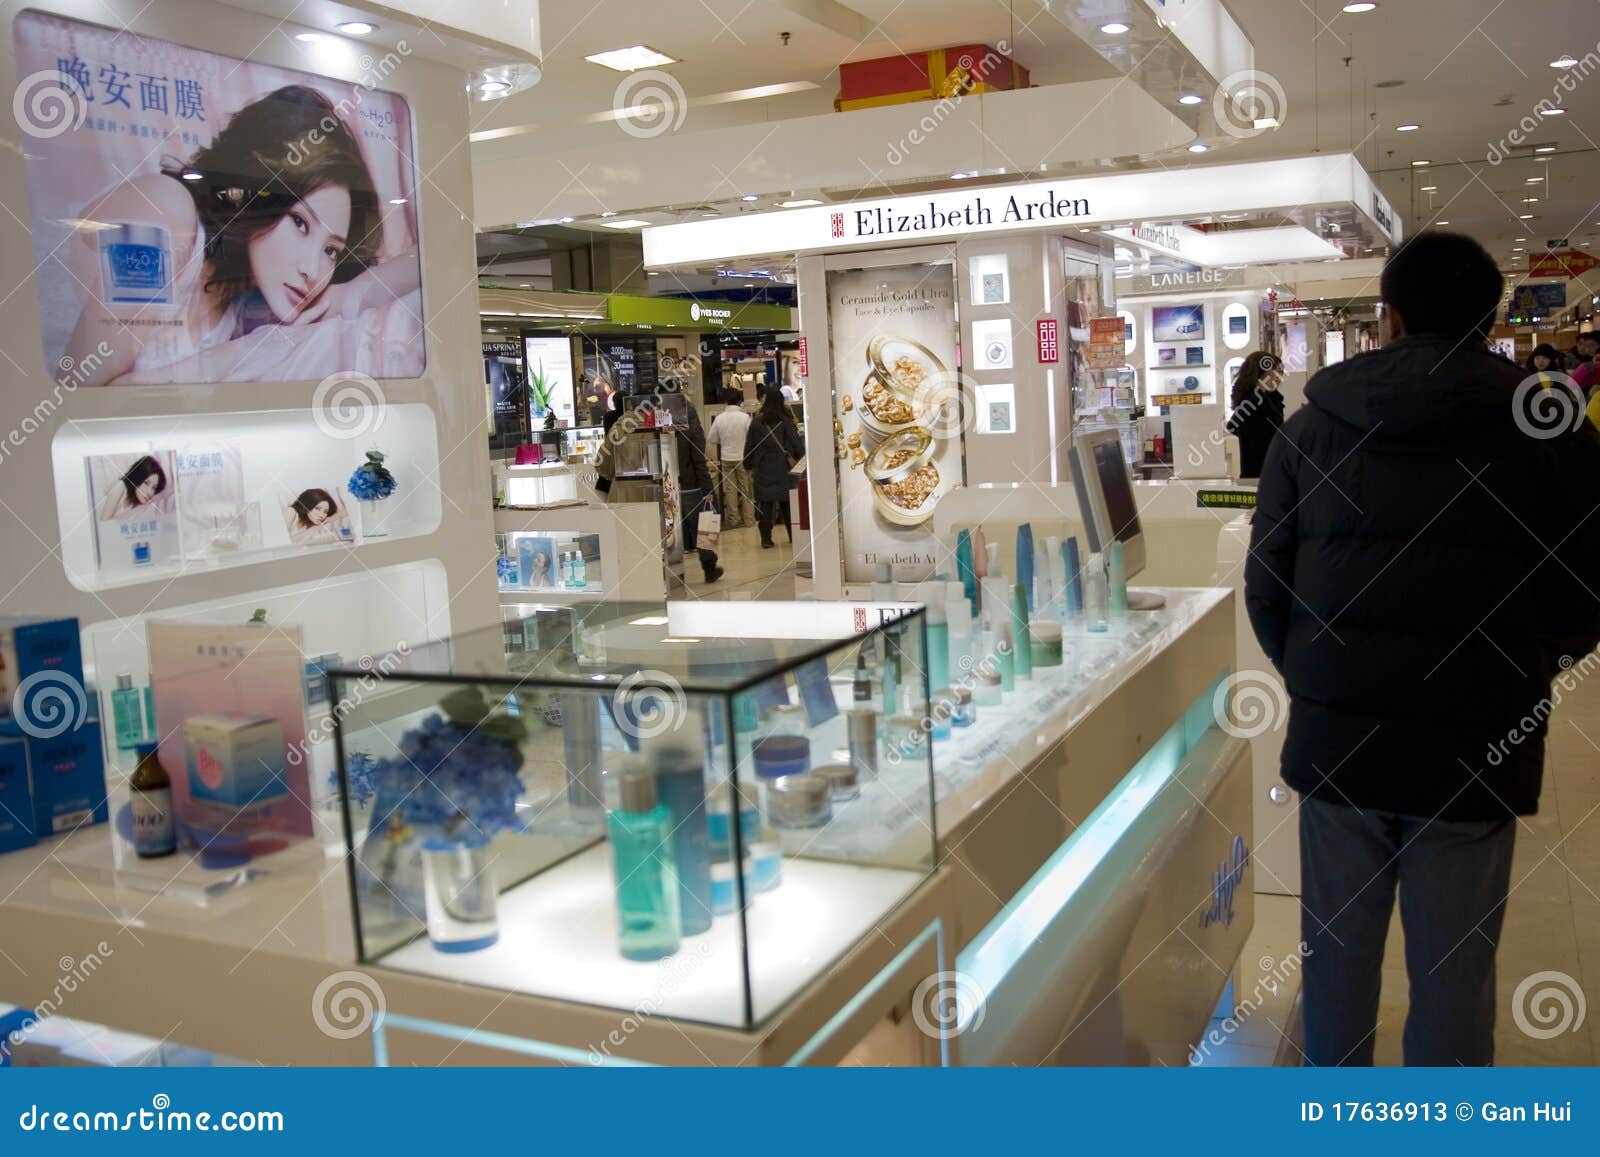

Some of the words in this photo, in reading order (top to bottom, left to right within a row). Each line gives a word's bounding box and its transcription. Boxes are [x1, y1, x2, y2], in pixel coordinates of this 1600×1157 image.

[56, 55, 206, 122] 晚安面膜
[855, 198, 993, 236] Elizabeth
[1001, 190, 1092, 224] Arden
[1151, 270, 1223, 288] LANEIGE
[840, 292, 888, 305] Ceramide
[892, 288, 917, 301] Gold
[921, 288, 949, 299] Ultra
[700, 308, 711, 317] YVES
[712, 309, 731, 318] ROCHER
